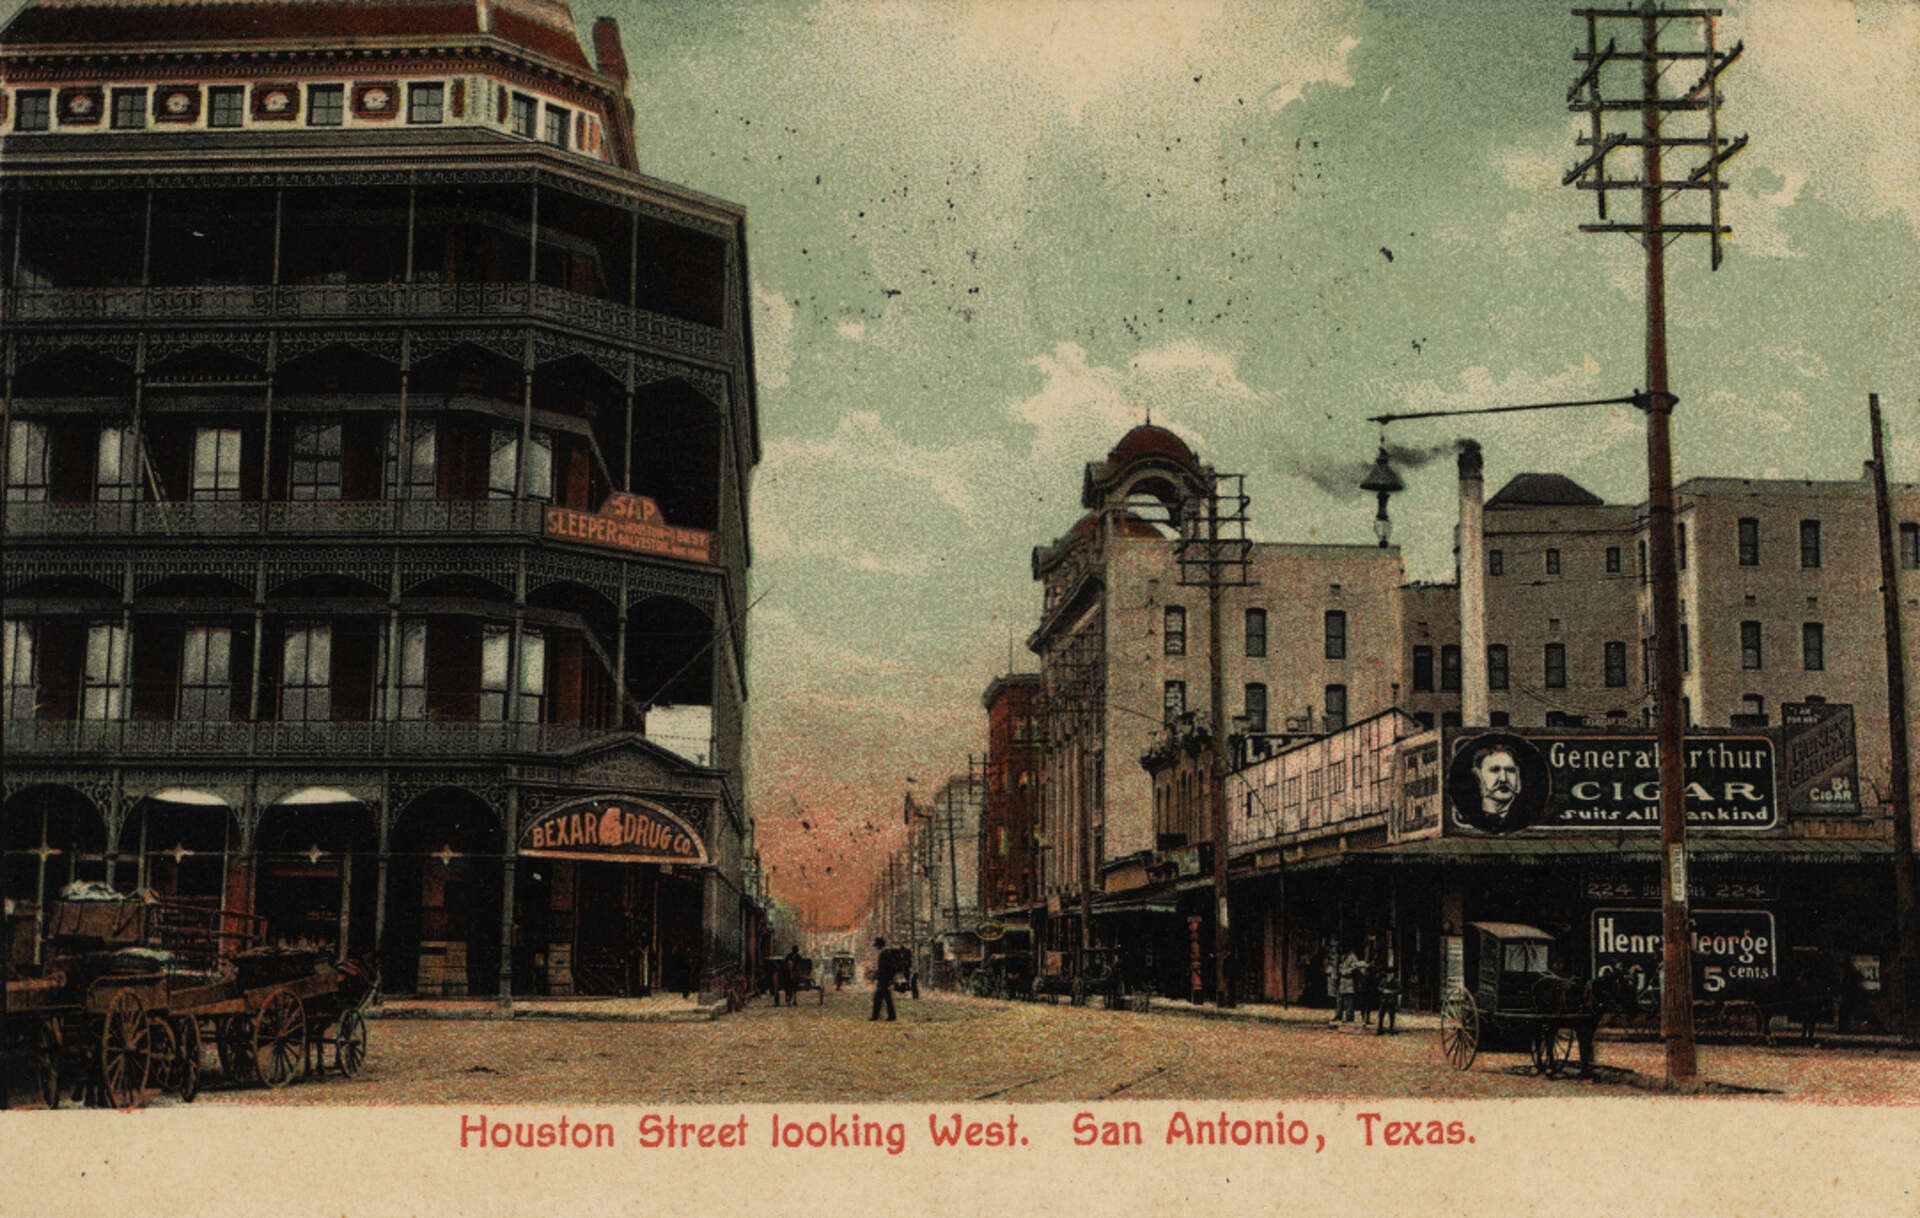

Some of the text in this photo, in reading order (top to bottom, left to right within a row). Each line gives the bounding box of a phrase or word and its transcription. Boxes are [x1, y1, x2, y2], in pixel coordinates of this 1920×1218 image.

[547, 511, 617, 543] SLEEPER
[1550, 742, 1767, 769] General rthur
[1571, 781, 1765, 802] CIGAR
[1686, 806, 1768, 821] ankind
[532, 811, 598, 848] BEXAR
[624, 812, 674, 851] DRUG
[1702, 966, 1726, 992] 5
